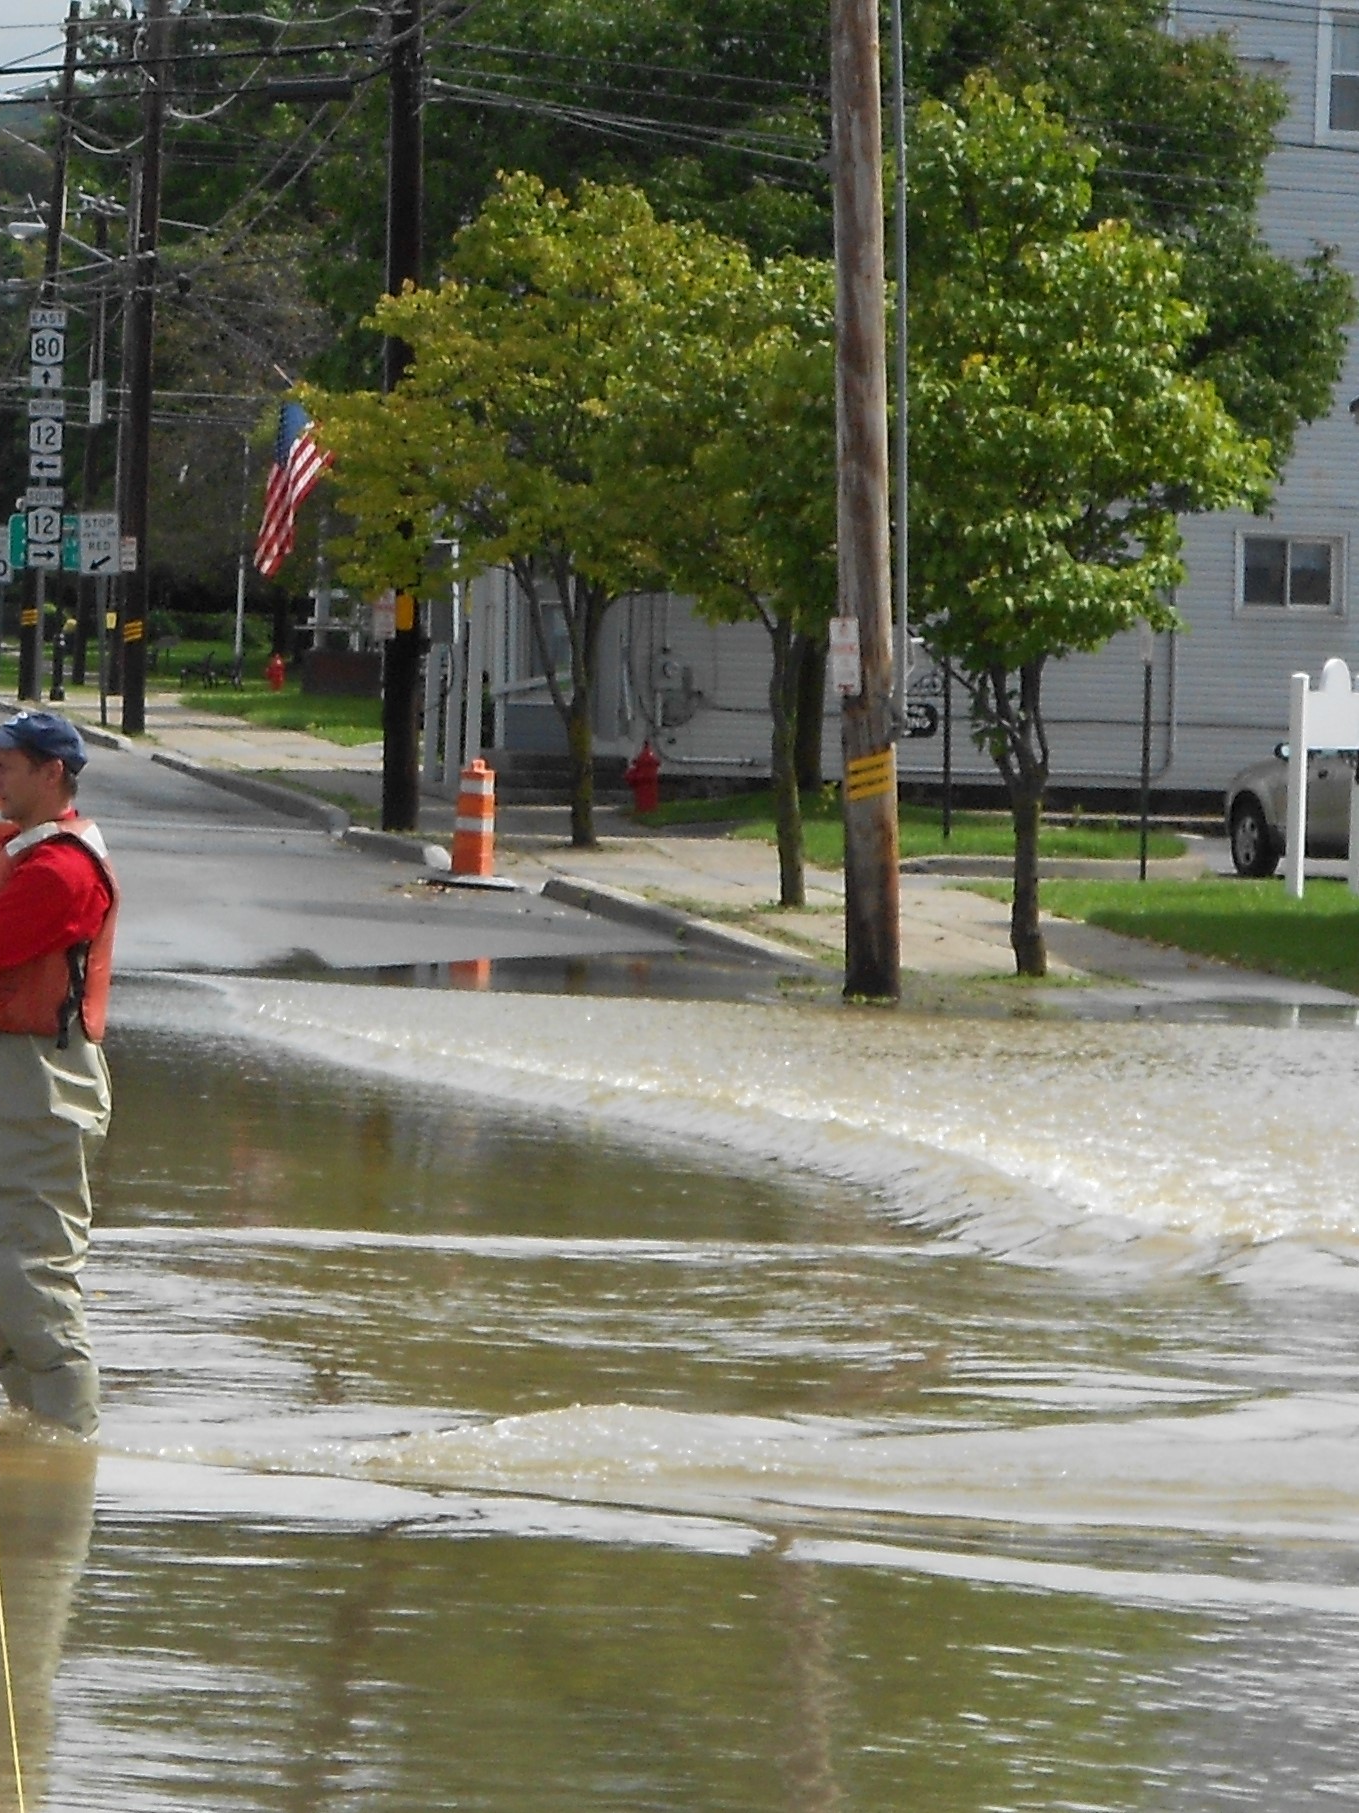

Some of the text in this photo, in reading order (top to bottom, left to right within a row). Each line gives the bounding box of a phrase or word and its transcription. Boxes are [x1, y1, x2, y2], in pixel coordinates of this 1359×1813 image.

[31, 313, 64, 324] EAST
[35, 337, 60, 357] 80
[36, 425, 56, 446] 12
[34, 514, 54, 535] 12
[84, 518, 114, 529] STOP
[88, 541, 111, 551] RED
